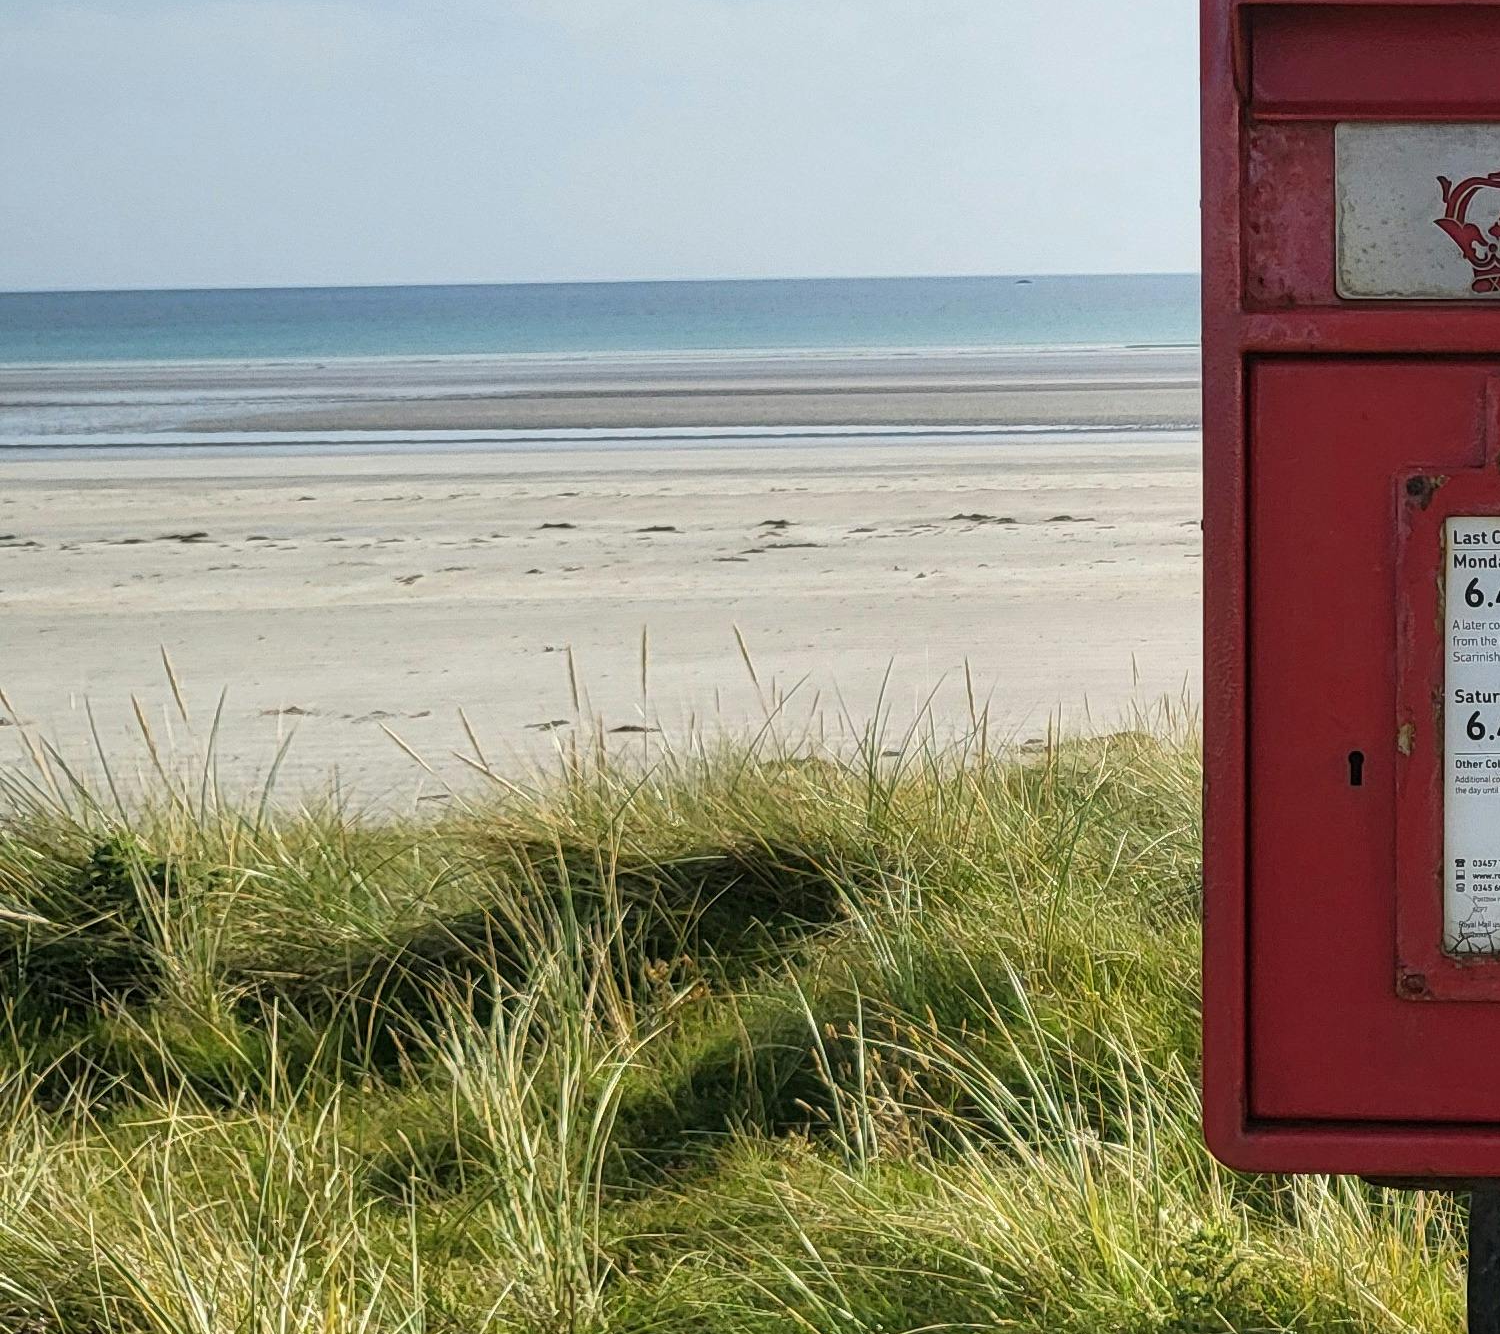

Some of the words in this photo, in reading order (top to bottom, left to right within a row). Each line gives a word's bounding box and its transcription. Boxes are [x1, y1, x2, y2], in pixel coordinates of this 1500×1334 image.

[1453, 529, 1489, 545] Last
[1452, 619, 1460, 631] A
[1462, 618, 1486, 630] later
[1452, 635, 1478, 647] from
[1480, 635, 1498, 647] the
[1453, 651, 1500, 663] Scarinish
[1455, 759, 1484, 769] Other
[1454, 775, 1491, 783] Additional
[1455, 786, 1467, 795] the
[1468, 786, 1481, 795] day
[1482, 786, 1499, 794] until
[1472, 859, 1498, 868] 03457
[1472, 883, 1493, 892] 0345
